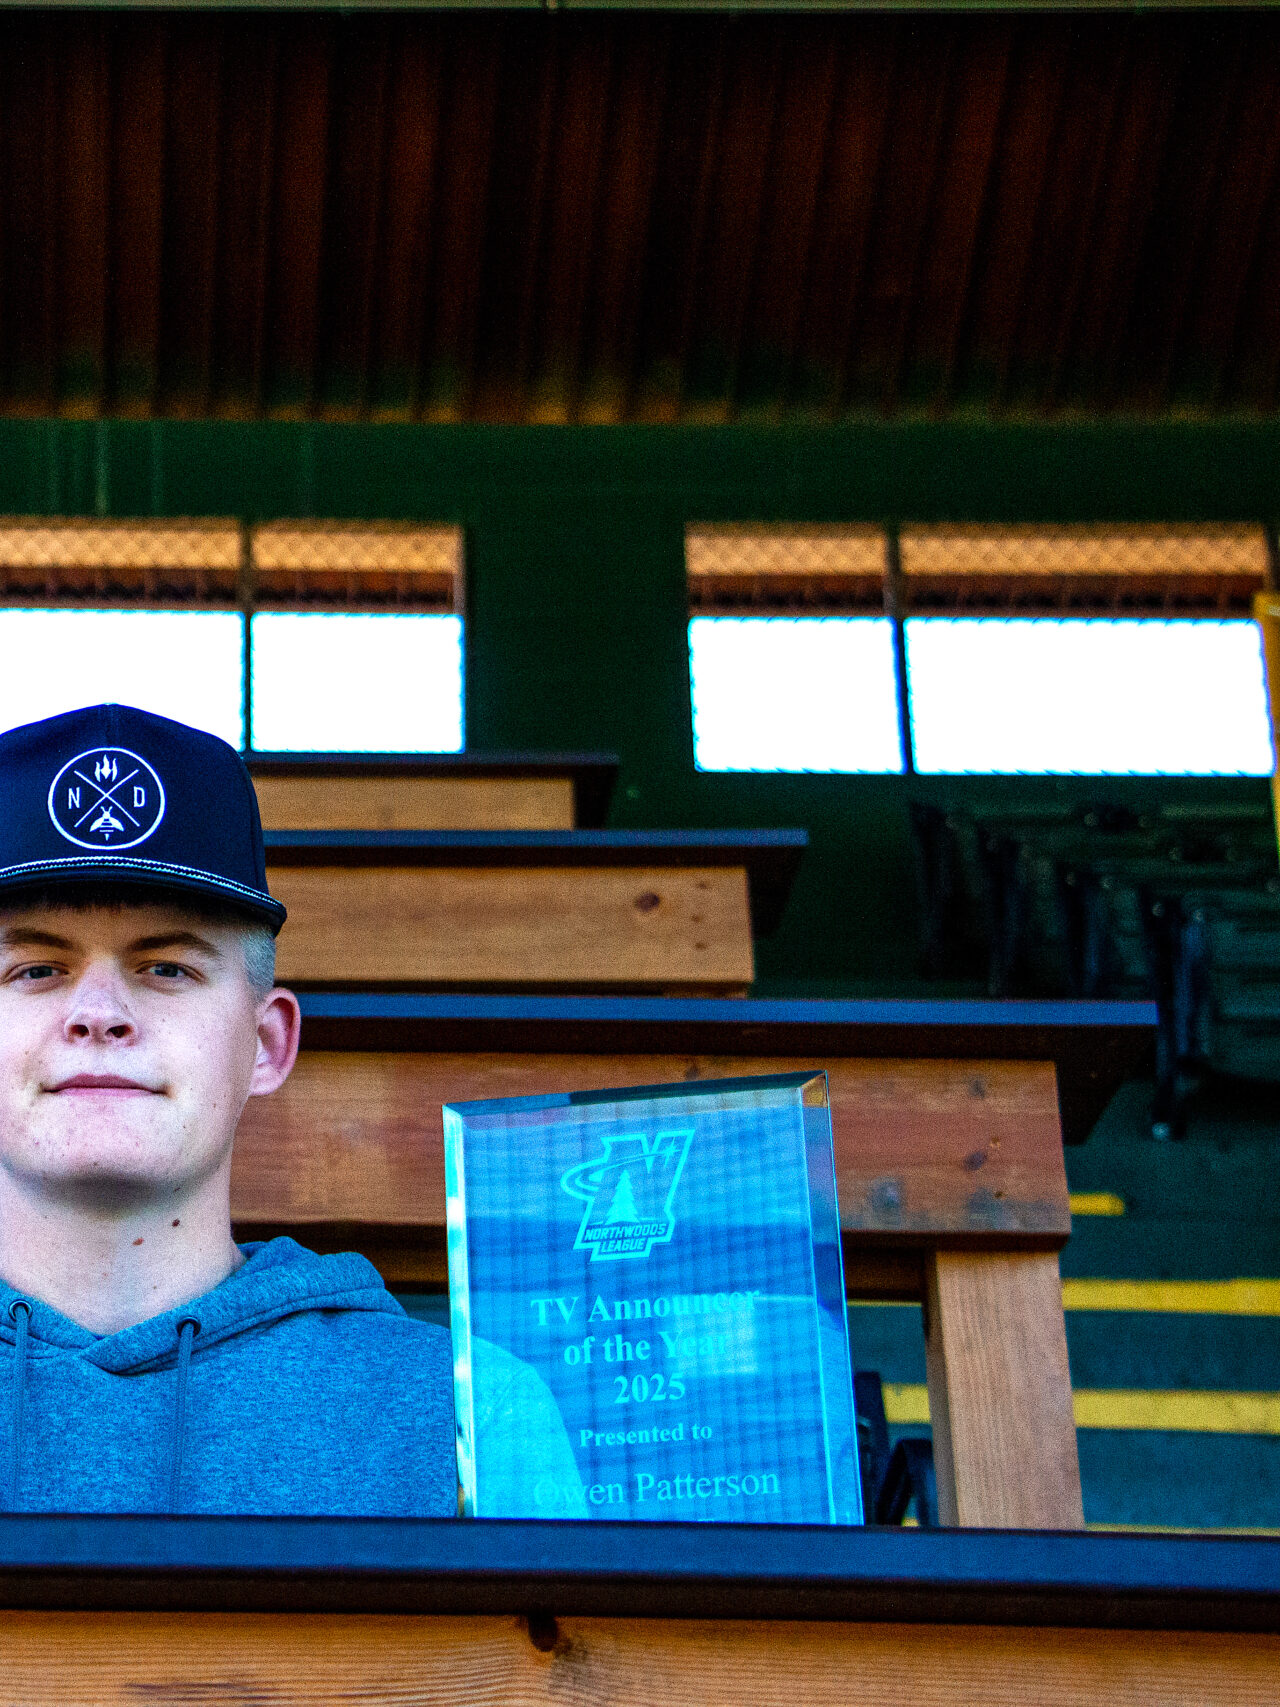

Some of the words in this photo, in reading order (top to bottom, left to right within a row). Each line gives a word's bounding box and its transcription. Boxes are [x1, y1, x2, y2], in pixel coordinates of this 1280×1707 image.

[68, 786, 80, 810] N
[133, 785, 145, 808] D
[584, 1223, 667, 1241] NORTHWOODS
[601, 1238, 646, 1253] LEAGUE
[531, 1296, 579, 1326] TV
[588, 1290, 760, 1323] Announcer
[563, 1336, 596, 1365] of
[603, 1334, 651, 1362] the
[658, 1330, 728, 1358] Year
[613, 1373, 686, 1404] 2025
[579, 1423, 684, 1447] Presented
[692, 1423, 712, 1440] to
[533, 1479, 626, 1505] Owen
[635, 1472, 781, 1502] Patterson
